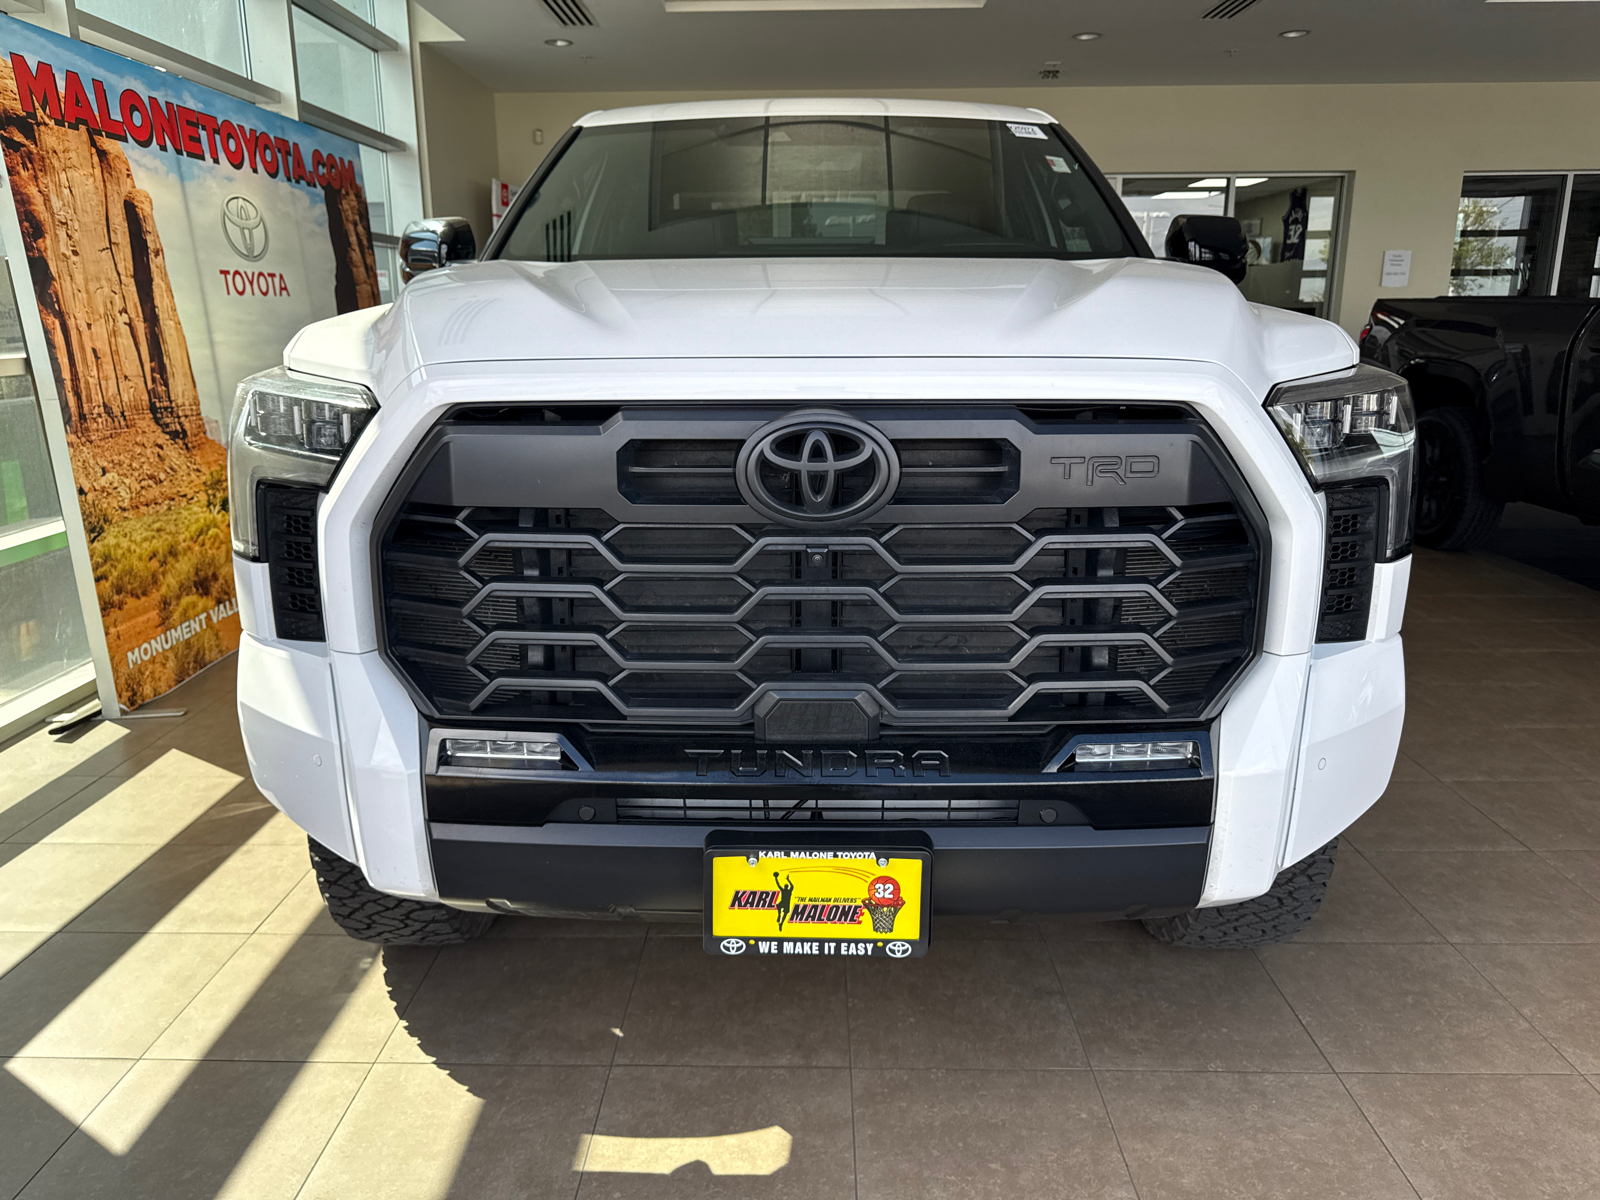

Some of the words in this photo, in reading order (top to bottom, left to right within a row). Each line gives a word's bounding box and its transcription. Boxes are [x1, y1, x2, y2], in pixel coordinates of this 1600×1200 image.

[9, 52, 358, 191] MALONETOYOTA.COM
[1286, 224, 1303, 244] 32
[219, 269, 291, 298] TOYOTA
[1050, 455, 1160, 486] TRD
[126, 612, 208, 669] MONUMENT
[684, 749, 950, 777] TUNDRA
[758, 851, 787, 859] KARL
[790, 851, 834, 859] MALONE
[836, 852, 877, 860] TOYOTA
[728, 890, 781, 910] KARL
[874, 883, 894, 899] 32
[788, 903, 865, 925] MALONE
[758, 941, 778, 954] WE
[782, 941, 819, 955] MAKE
[824, 942, 837, 955] IT
[841, 942, 874, 956] EASY
